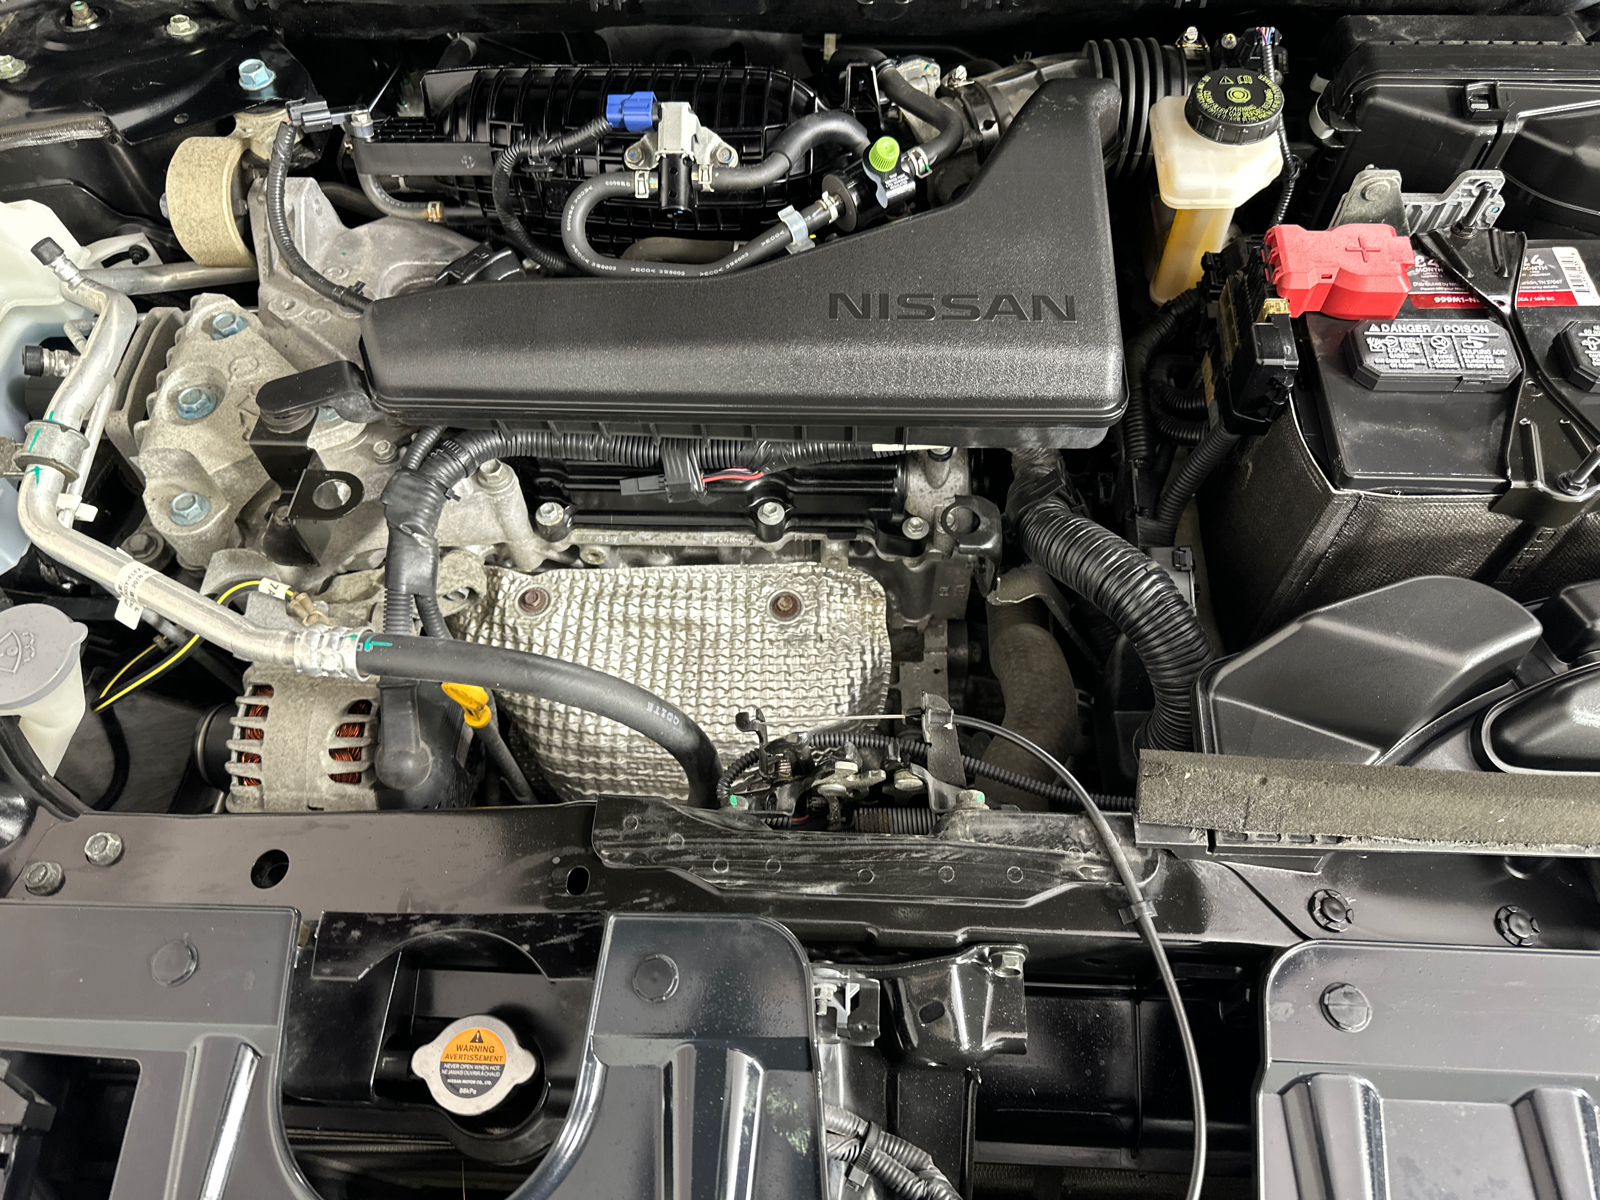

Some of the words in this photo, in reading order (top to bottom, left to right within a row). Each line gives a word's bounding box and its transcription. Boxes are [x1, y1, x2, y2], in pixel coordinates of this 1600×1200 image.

[829, 292, 1077, 324] NISSAN
[1380, 324, 1431, 332] DANGER
[1443, 324, 1489, 333] POISON
[456, 1044, 494, 1053] WARNING
[445, 1053, 503, 1062] AVERTISSEMENT
